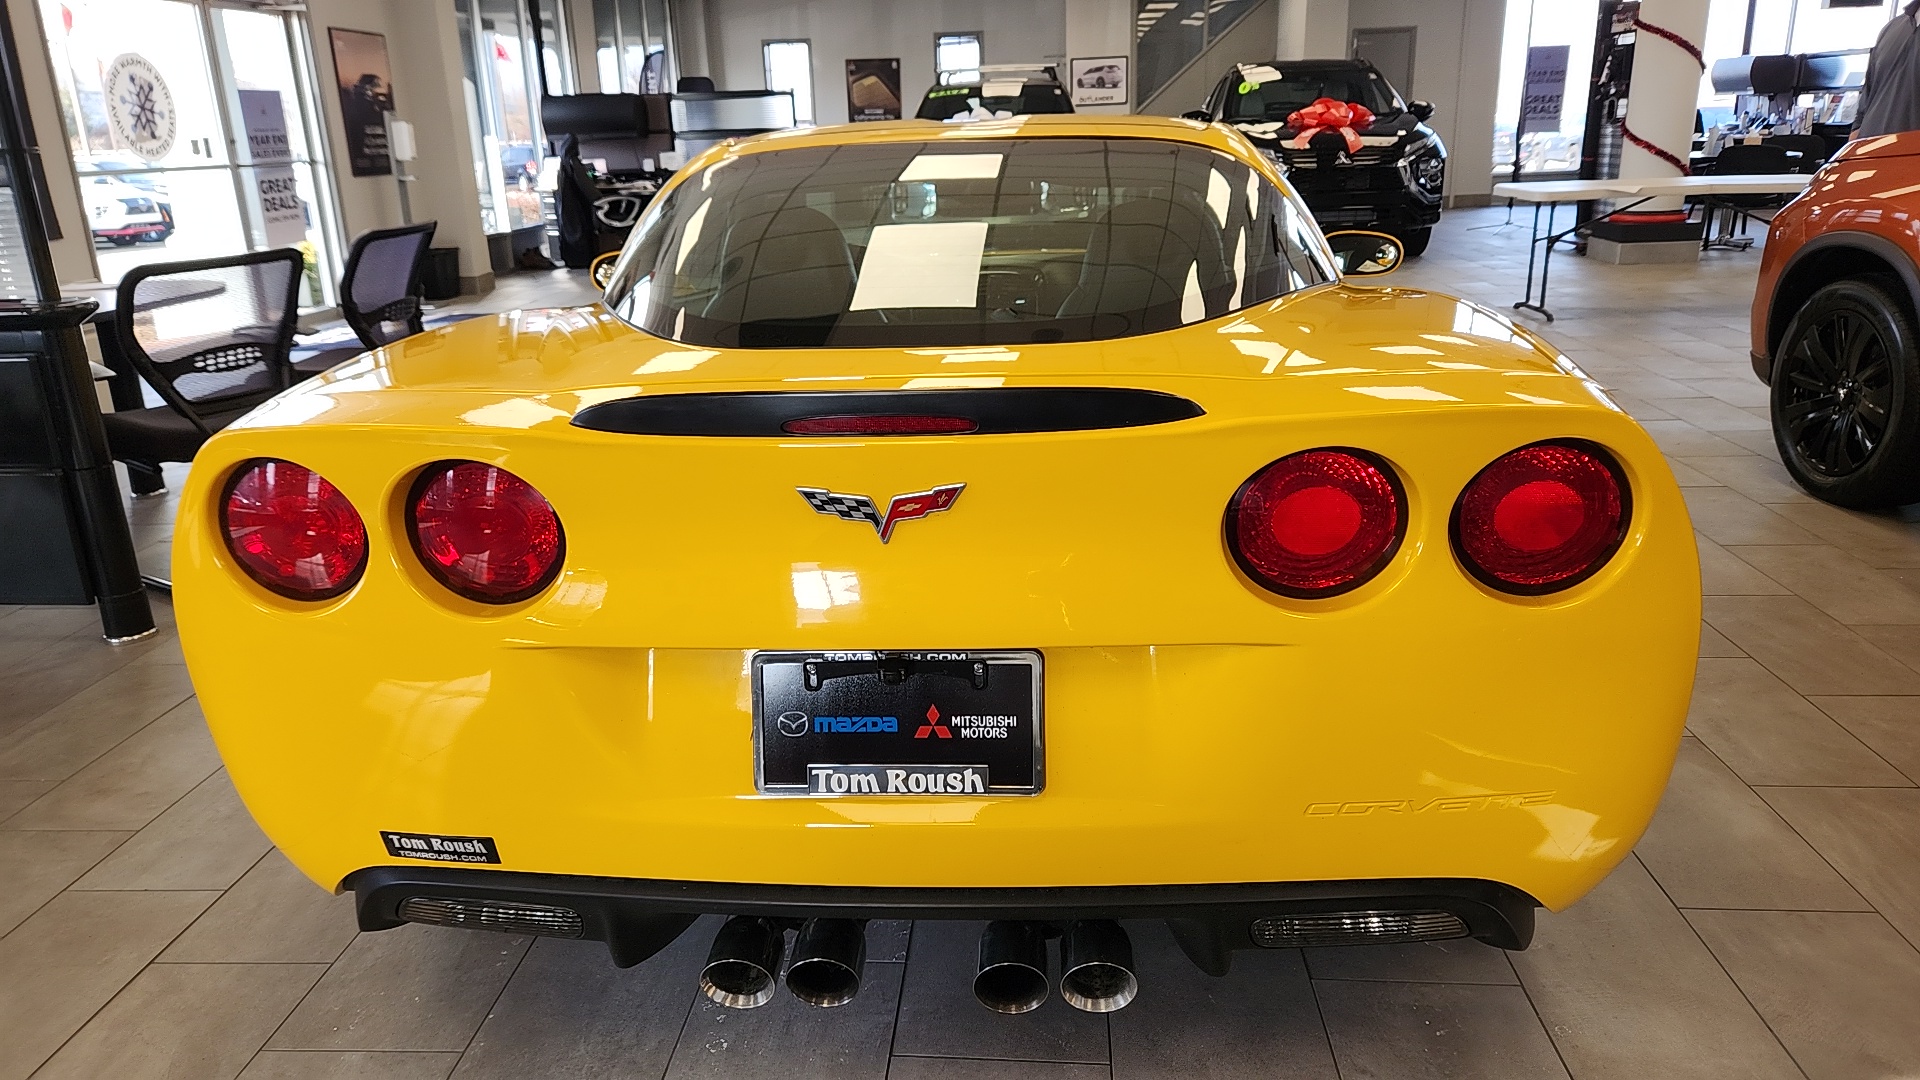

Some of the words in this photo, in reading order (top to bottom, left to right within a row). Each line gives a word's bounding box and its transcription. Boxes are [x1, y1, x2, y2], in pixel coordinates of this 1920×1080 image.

[1079, 95, 1114, 103] OUTLANDER
[249, 134, 271, 147] YEAR
[260, 177, 296, 195] GREAT
[263, 194, 299, 213] DEALS
[951, 715, 1017, 727] MITSUBISHI
[961, 727, 1008, 739] MOTORS
[811, 768, 881, 793] Tom
[886, 767, 985, 793] Roush
[1303, 789, 1557, 817] CORVETTE
[388, 834, 430, 851] Tom
[429, 837, 489, 854] Roush
[398, 850, 488, 862] TOMROUSH.COM
